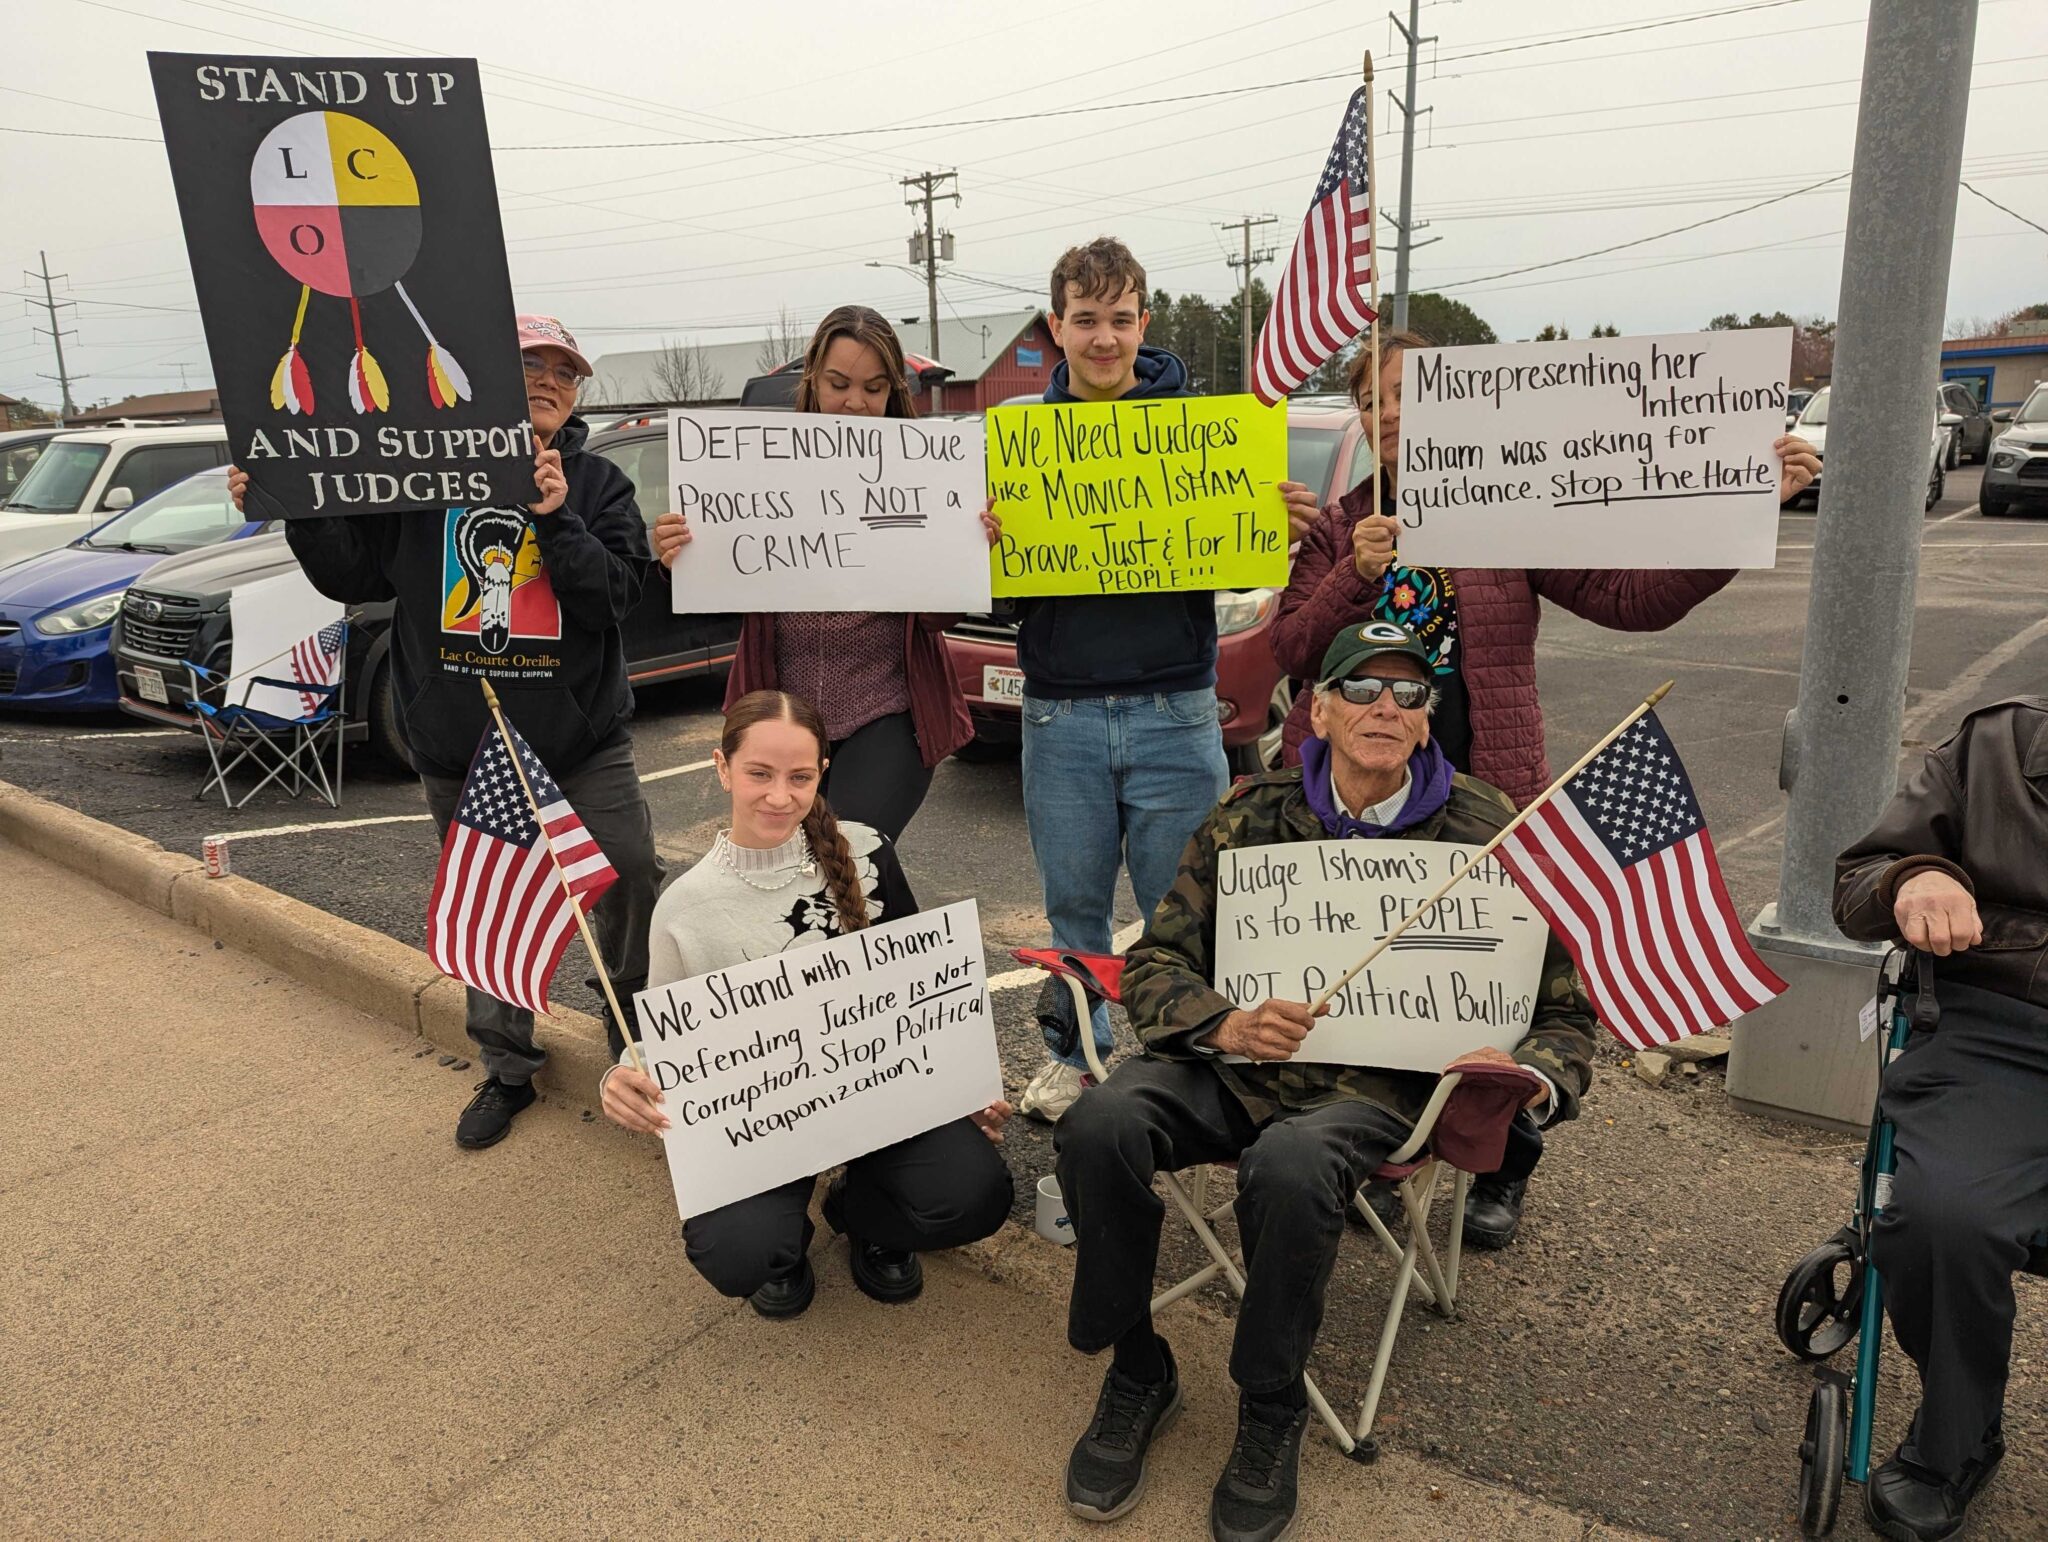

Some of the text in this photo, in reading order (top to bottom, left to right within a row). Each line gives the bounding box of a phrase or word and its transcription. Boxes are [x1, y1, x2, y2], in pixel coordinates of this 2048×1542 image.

[196, 65, 455, 105] STAND UP
[278, 147, 379, 180] L C
[290, 224, 325, 256] O
[1417, 343, 1707, 409] Misrepresenting her
[246, 427, 362, 460] AND
[899, 423, 966, 462] Due
[994, 402, 1239, 475] We Need Judges
[1405, 424, 1716, 473] Isham was asking for
[308, 471, 491, 510] JUDGES
[678, 483, 962, 524] PROCESS IS NOT a
[1041, 468, 1153, 520] MONICA
[1401, 476, 1542, 529] guidance.
[1632, 464, 1700, 491] the
[1702, 455, 1776, 489] Hate.
[732, 532, 866, 575] CRIME
[1185, 516, 1226, 560] For
[1231, 511, 1281, 554] The
[1437, 567, 1455, 598] ILLES
[440, 648, 560, 667] Lac Courte Oreilles
[443, 664, 459, 672] BAND
[472, 668, 486, 676] LAKE
[489, 670, 519, 678] SUPERIOR
[1218, 852, 1302, 907] Judge
[1318, 845, 1428, 884] Isham's
[1234, 914, 1259, 940] is
[1267, 905, 1301, 937] to
[1308, 901, 1361, 933] the
[1380, 894, 1493, 933] PEOPLE
[641, 912, 954, 1042] We Stand with Isham!
[1225, 971, 1282, 1006] NOT
[1450, 970, 1530, 1026] Bullies
[654, 1026, 802, 1091] Defending
[819, 991, 898, 1036] Justice
[934, 956, 977, 989] Not
[682, 987, 985, 1127] Corruption. Stop Political
[725, 1045, 934, 1147] Weaponization!
